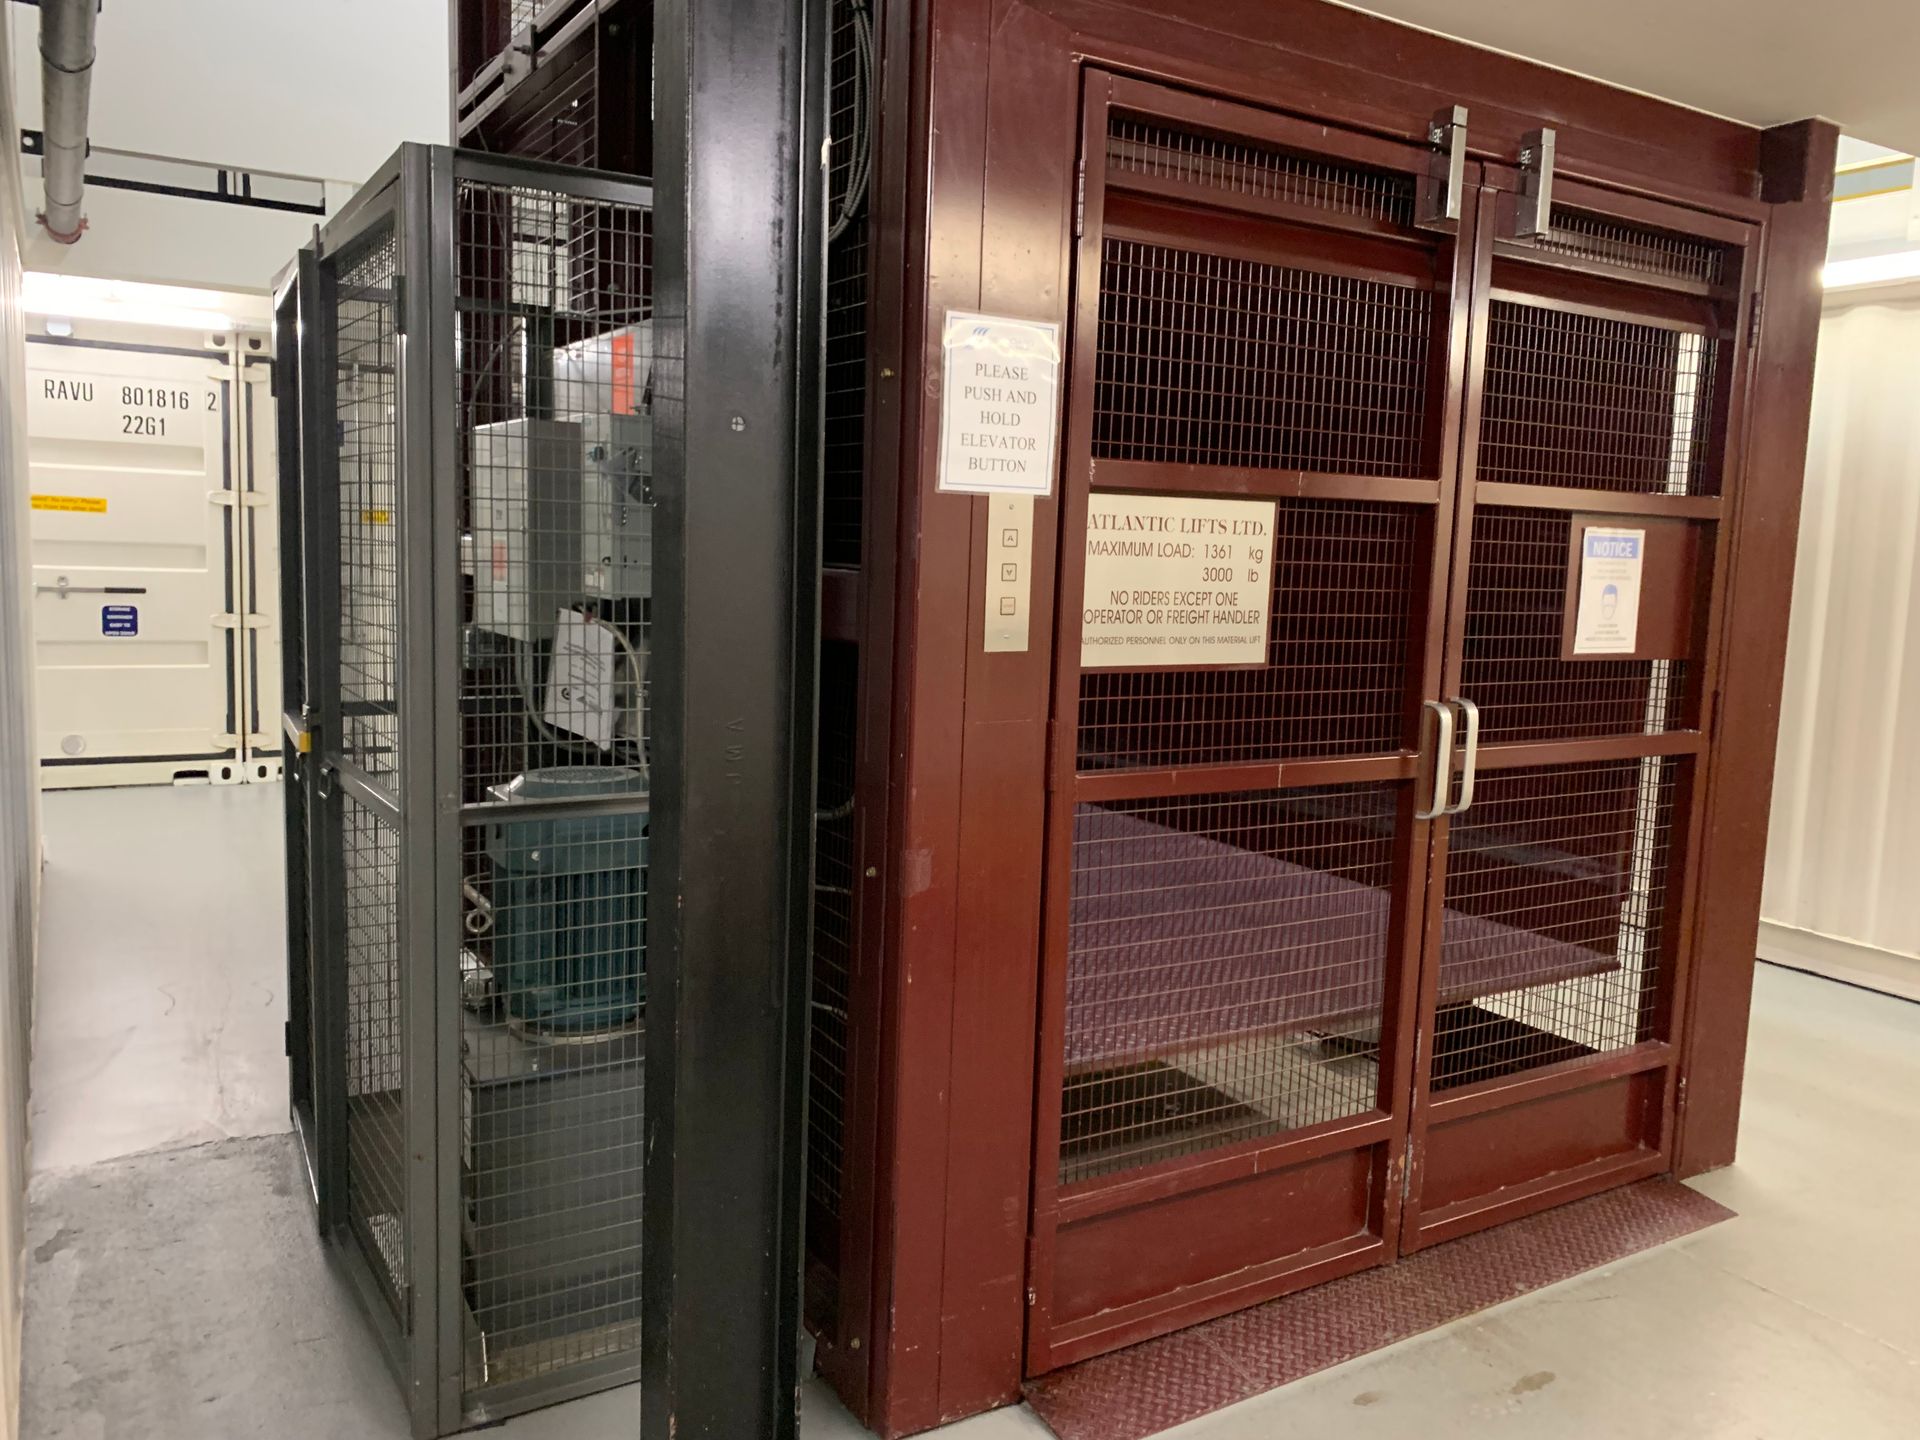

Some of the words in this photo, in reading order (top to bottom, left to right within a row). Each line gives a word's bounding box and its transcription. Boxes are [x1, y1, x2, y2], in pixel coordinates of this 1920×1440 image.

[975, 362, 1029, 381] PLEASE
[44, 379, 93, 401] RAVU
[122, 386, 189, 410] 801816
[207, 392, 217, 411] 2
[964, 386, 1002, 402] PUSH
[1006, 390, 1037, 405] AND
[122, 415, 165, 436] 22G1
[980, 410, 1021, 426] HOLD
[960, 433, 1036, 451] ELEVATOR
[968, 457, 1027, 473] BUTTON
[1087, 513, 1175, 533] ATLANTIC
[1180, 517, 1228, 535] LIFTS
[1232, 520, 1267, 537] LTD.
[1088, 540, 1153, 557] MAXIMUM
[1157, 542, 1195, 558] LOAD:
[1204, 544, 1232, 560] 1361
[1249, 546, 1264, 564] kg
[1593, 541, 1633, 557] NOTICE
[1202, 567, 1233, 582] 3000
[1247, 568, 1259, 583] lb
[1110, 590, 1129, 606] NO
[1132, 590, 1170, 606] RIDERS
[1173, 591, 1212, 606] EXCEPT
[1215, 591, 1238, 606] ONE
[1084, 609, 1142, 624] OPERATOR
[1146, 609, 1163, 624] OR
[1166, 609, 1210, 624] FREIGHT
[1213, 610, 1260, 625] HANDLER
[1126, 636, 1166, 645] PERSONNEL
[1169, 636, 1187, 645] ONLY
[1189, 636, 1200, 645] ON
[1202, 636, 1216, 645] THIS
[1217, 635, 1247, 645] MATERIAL
[1249, 635, 1261, 645] LIFT
